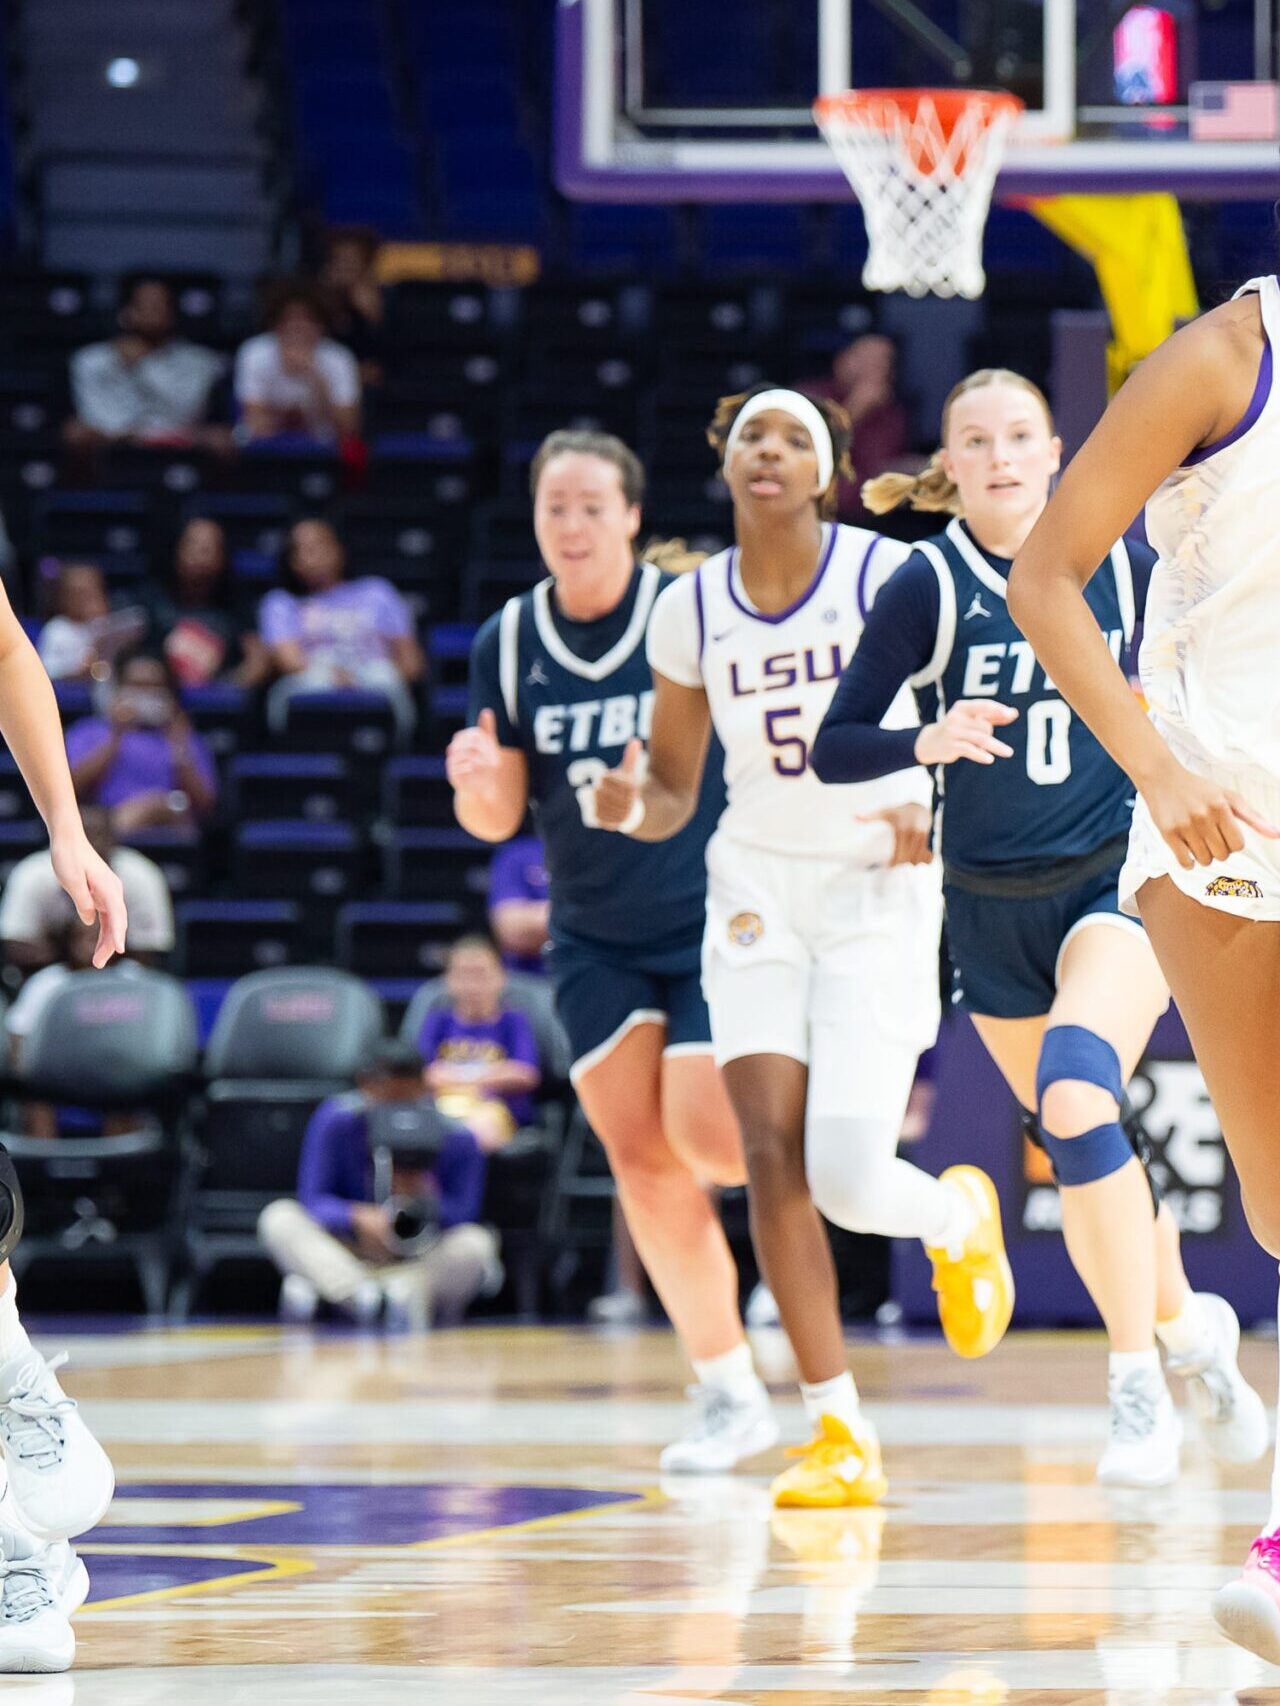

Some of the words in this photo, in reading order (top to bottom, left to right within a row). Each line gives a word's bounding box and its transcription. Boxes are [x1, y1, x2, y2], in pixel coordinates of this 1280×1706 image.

[730, 645, 844, 696] LSU
[962, 629, 1123, 697] ET
[765, 706, 807, 776] 5
[1026, 699, 1071, 785] 0
